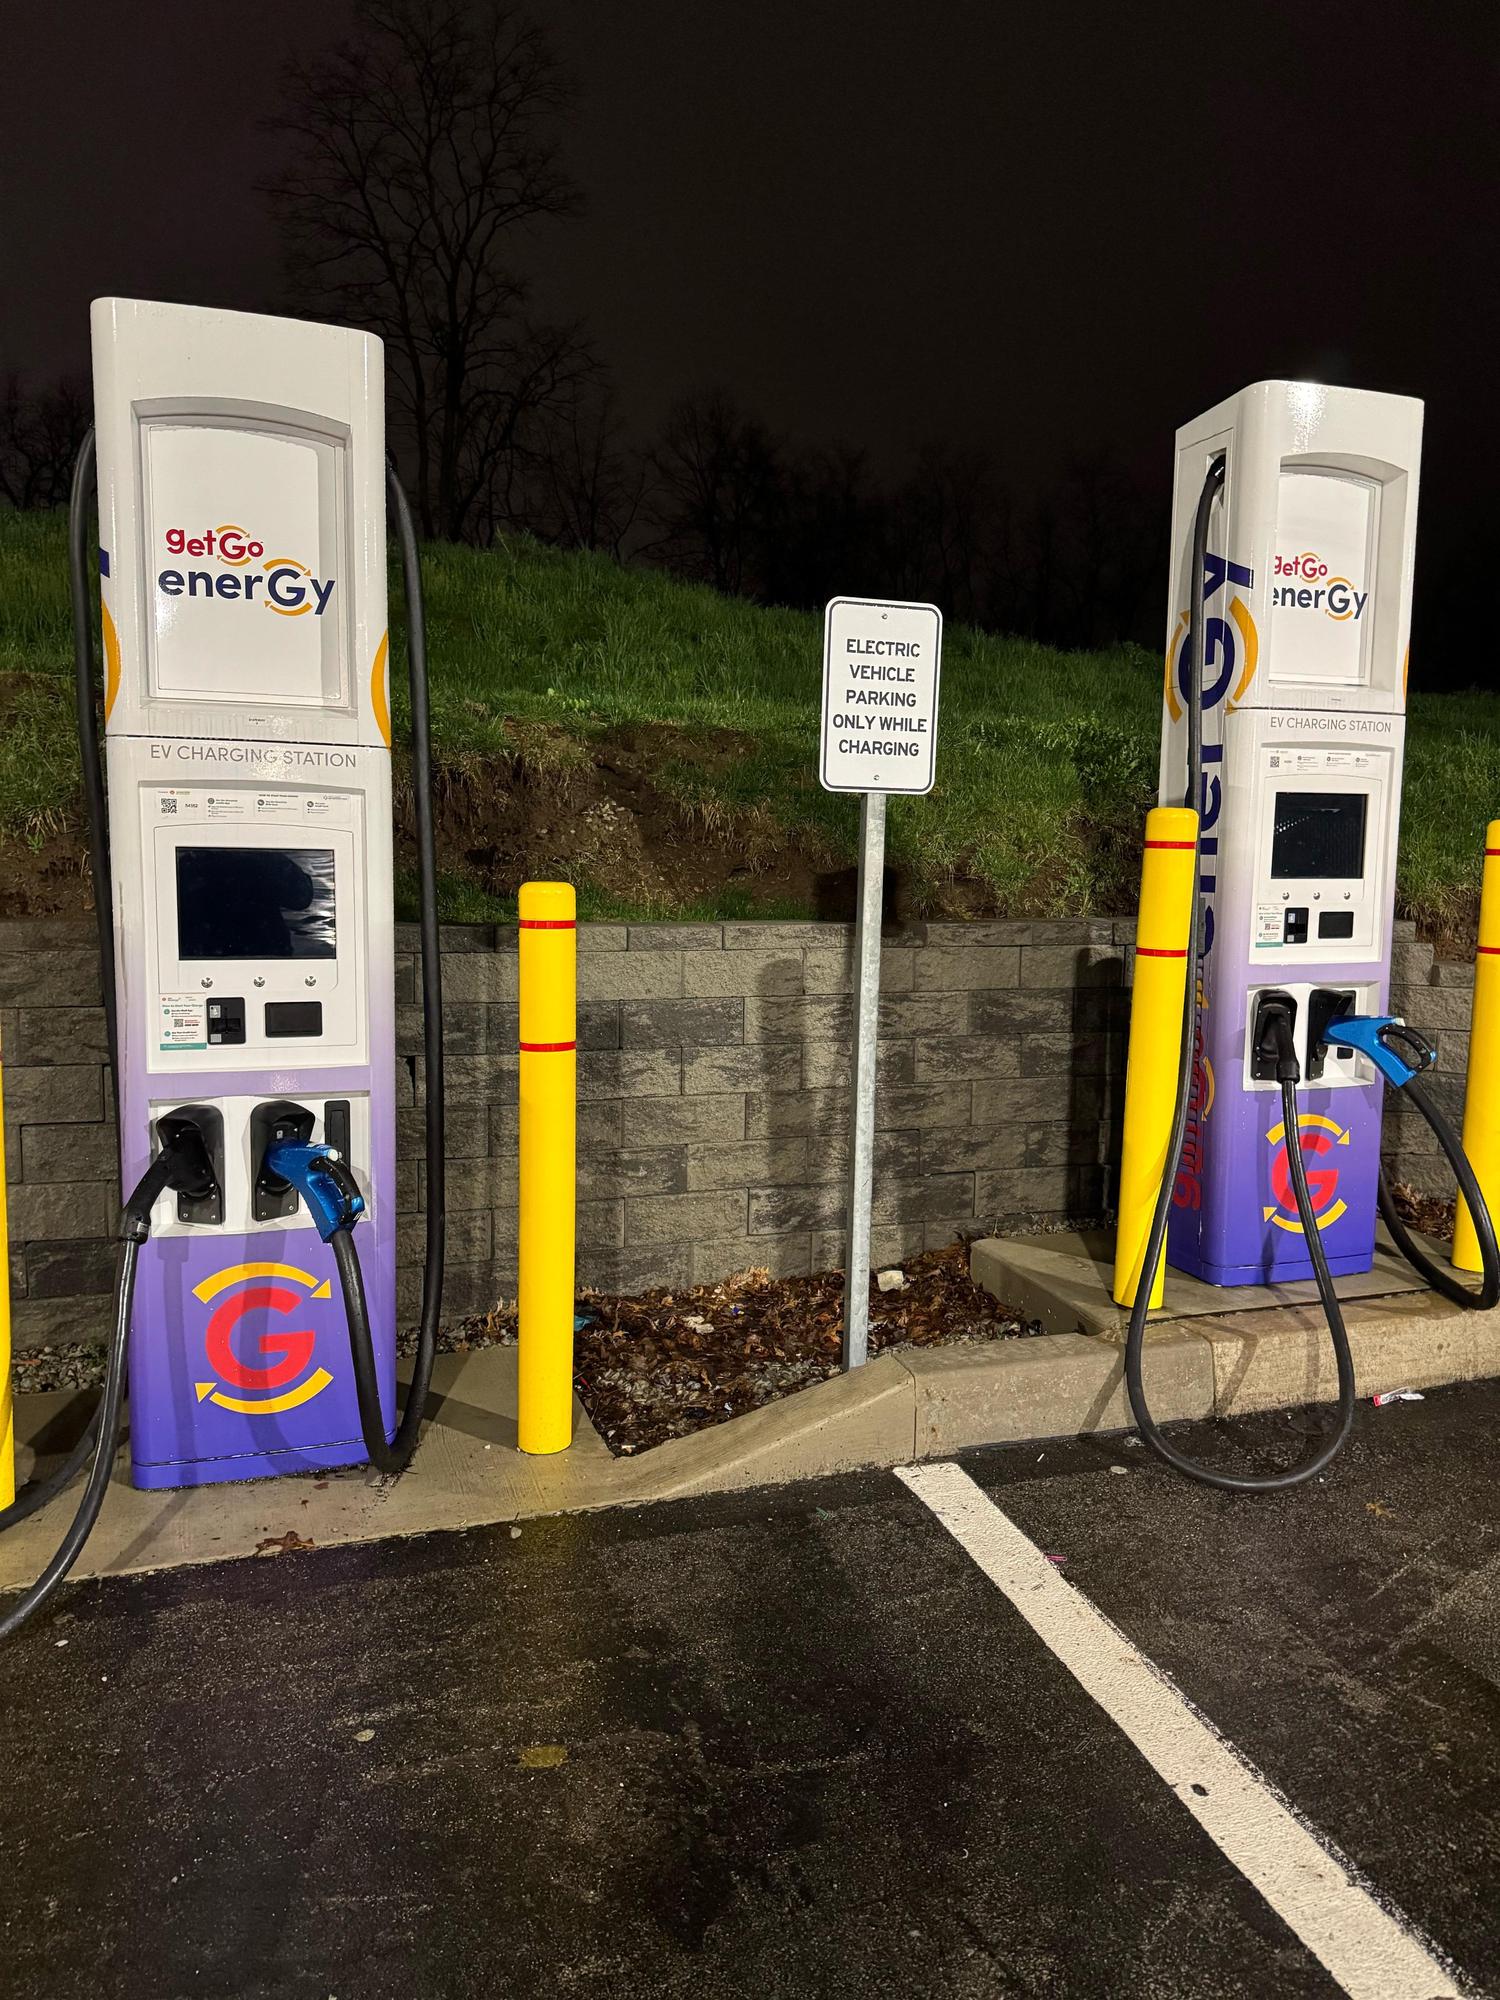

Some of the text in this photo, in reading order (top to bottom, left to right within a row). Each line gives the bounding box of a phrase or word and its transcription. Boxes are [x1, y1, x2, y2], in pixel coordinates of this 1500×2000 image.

[166, 529, 264, 559] getGo
[158, 568, 336, 616] enerGy
[846, 638, 920, 658] ELECTRIC
[850, 664, 915, 682] VEHICLE
[845, 689, 917, 707] PARKING
[833, 714, 927, 733] ONLY WHILE
[1270, 716, 1392, 733] EV CHARGING STATION
[150, 745, 356, 768] EV CHARGING STATION
[838, 739, 920, 757] CHARGING
[205, 1287, 315, 1391] G
